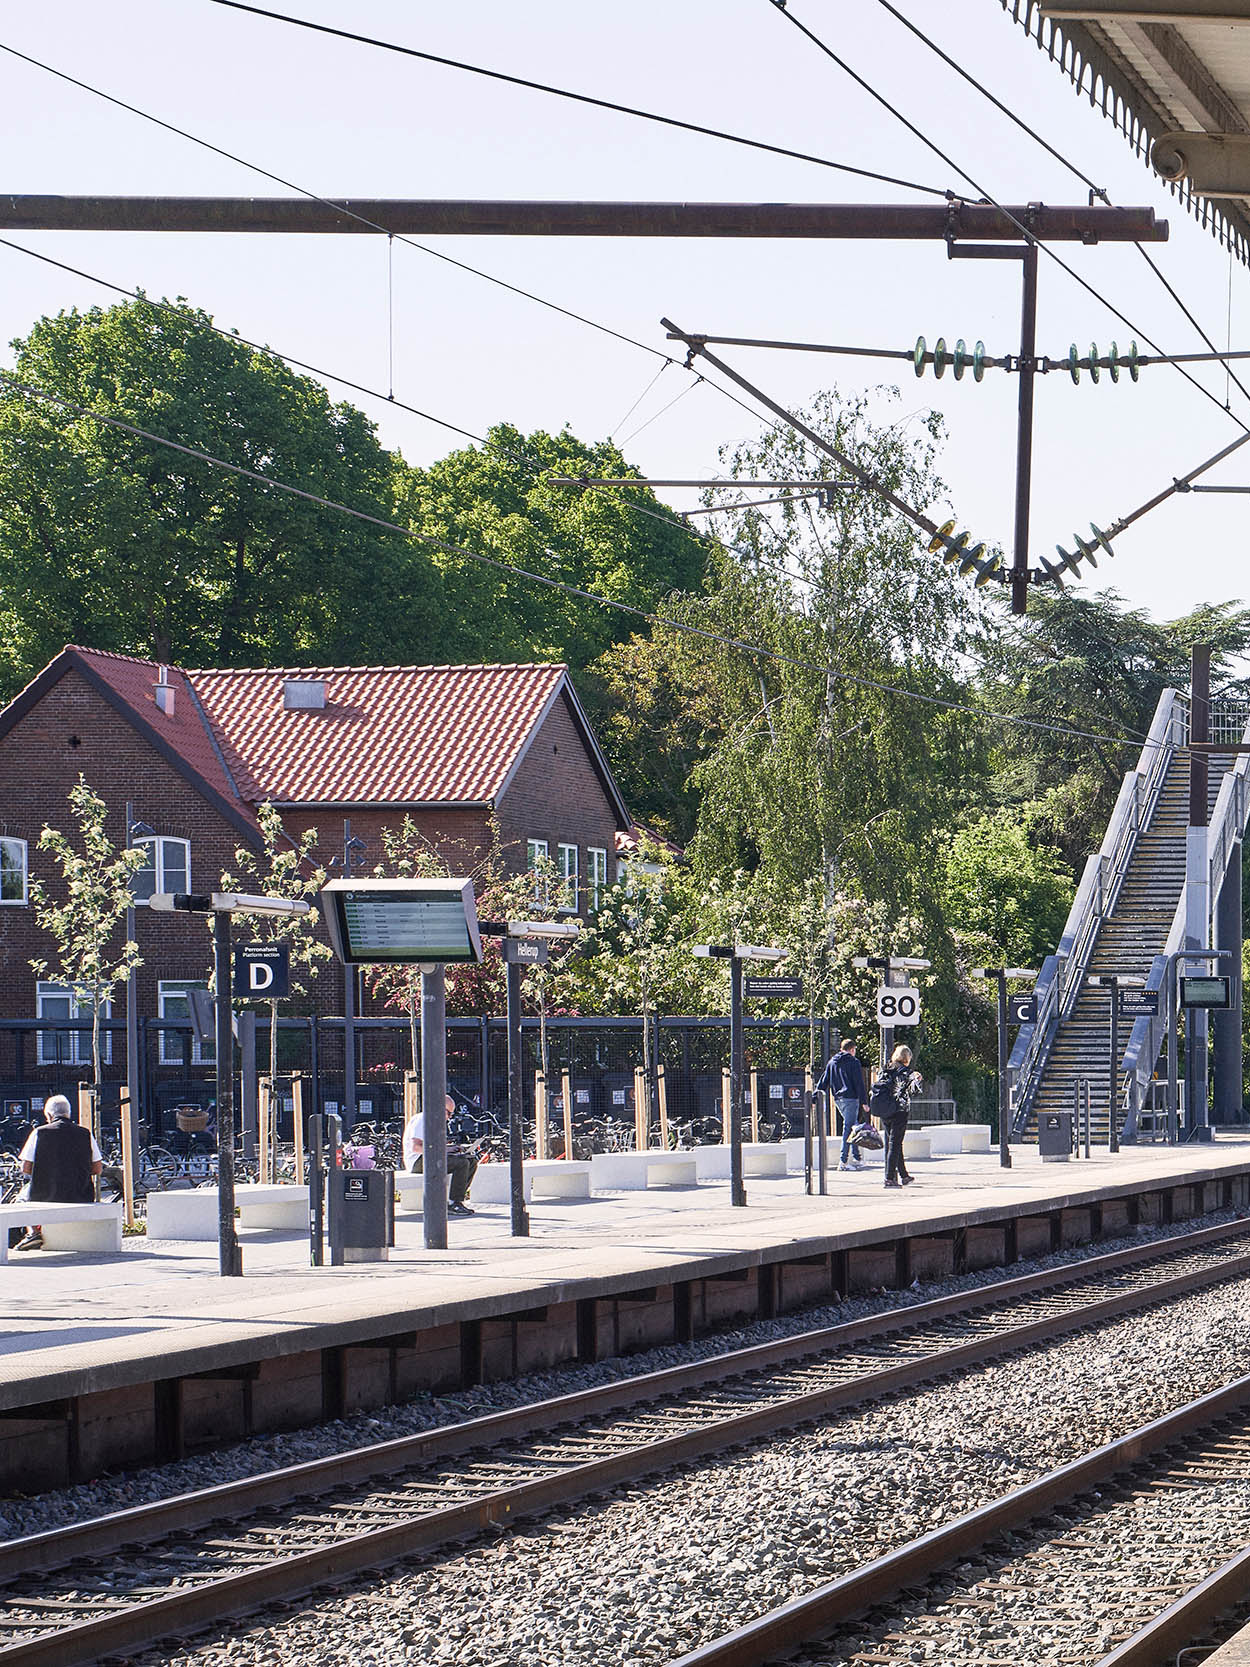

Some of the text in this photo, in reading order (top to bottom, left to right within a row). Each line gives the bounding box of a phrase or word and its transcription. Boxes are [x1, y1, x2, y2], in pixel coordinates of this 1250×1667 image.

[517, 942, 539, 960] Hellerup
[249, 963, 274, 990] D
[880, 995, 916, 1017] 80
[1017, 1005, 1030, 1020] C
